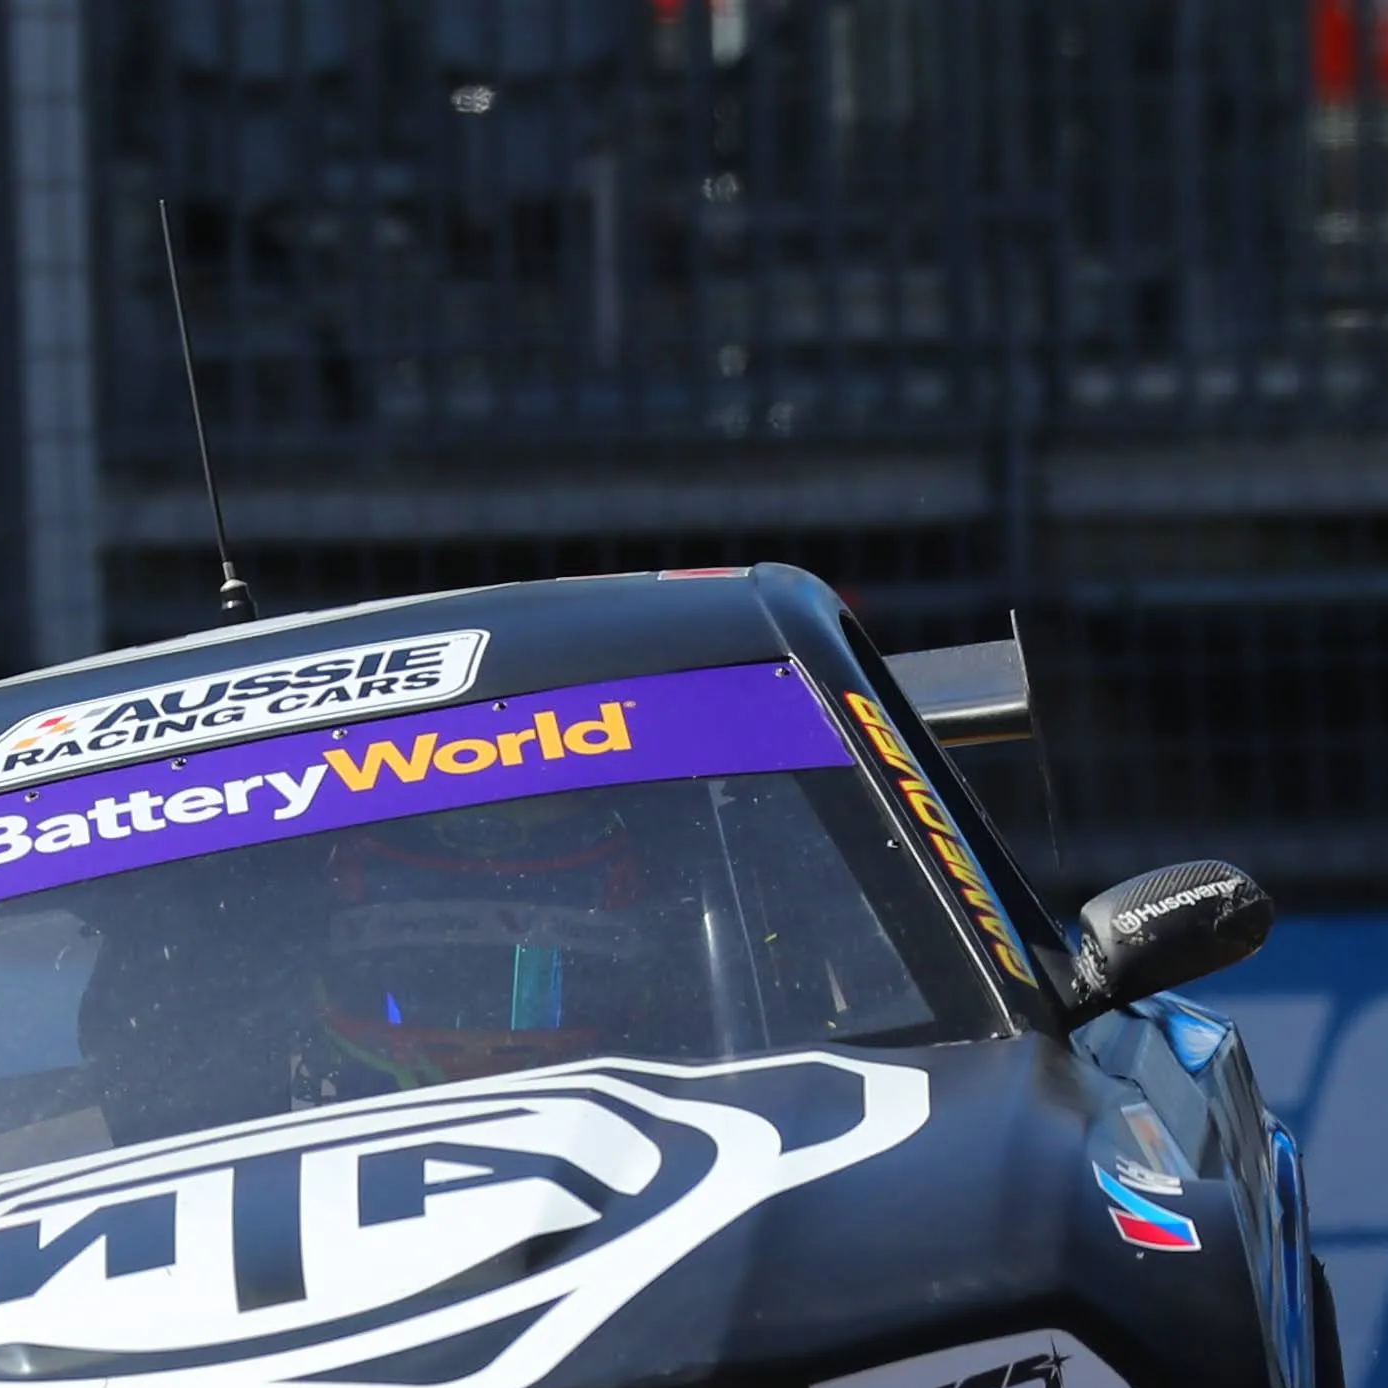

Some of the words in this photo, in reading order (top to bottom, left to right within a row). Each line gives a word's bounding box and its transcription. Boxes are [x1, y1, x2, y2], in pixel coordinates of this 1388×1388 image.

[0, 706, 248, 773] RACING
[267, 670, 443, 715] CARS
[90, 640, 452, 733] AUSSIE
